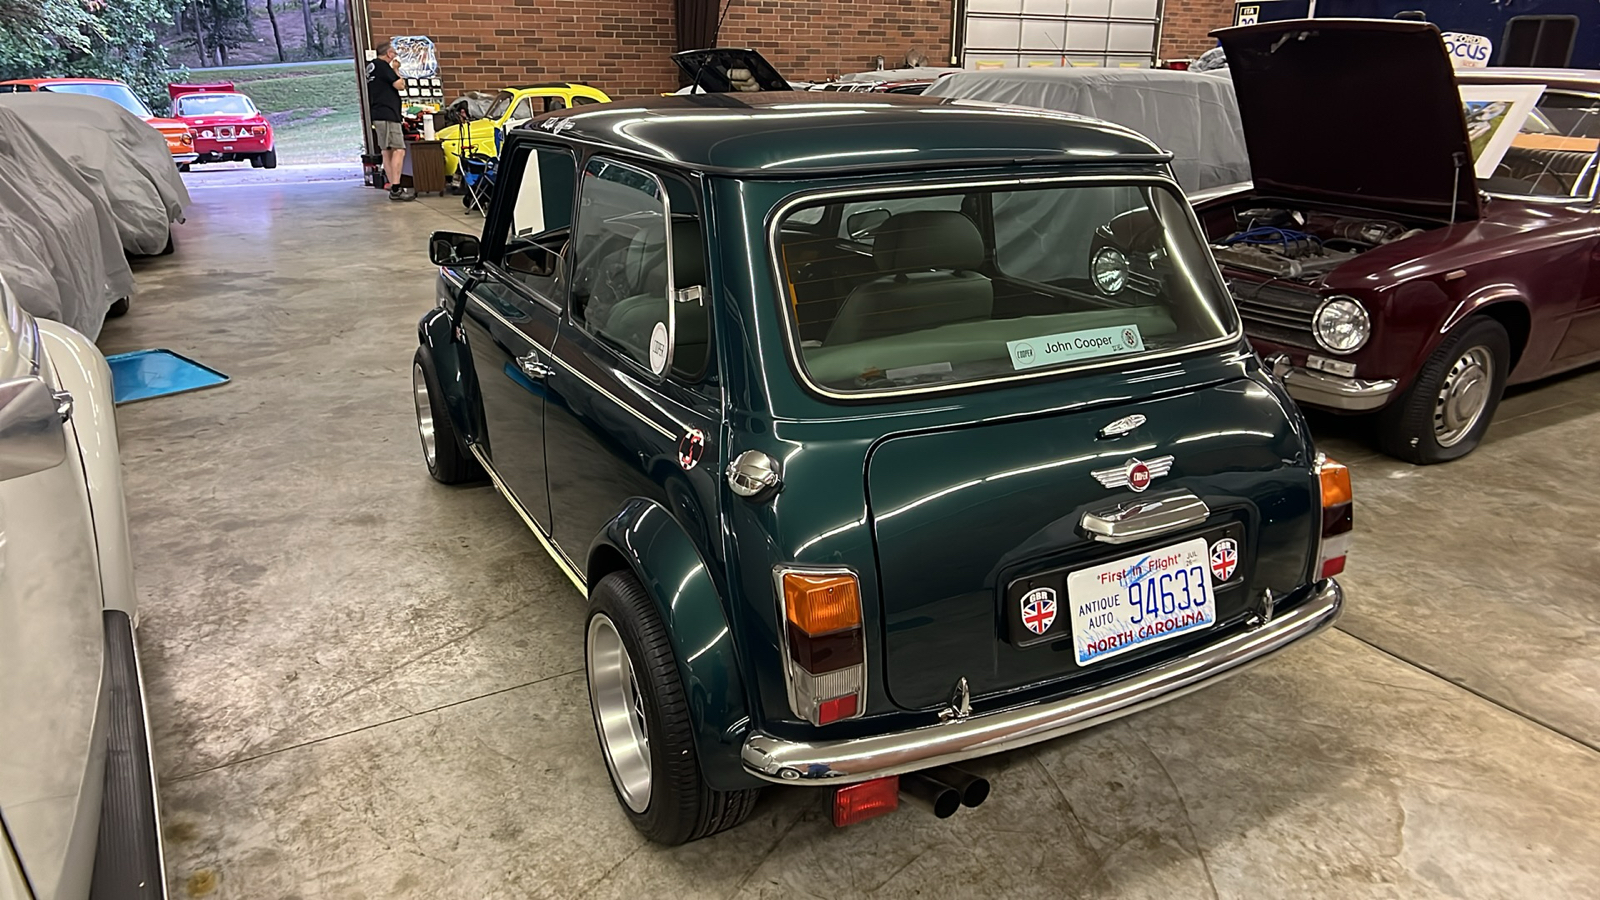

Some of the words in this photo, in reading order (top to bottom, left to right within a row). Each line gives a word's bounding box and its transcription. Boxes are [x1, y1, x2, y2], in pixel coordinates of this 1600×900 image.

[1045, 342, 1073, 354] John
[1074, 336, 1112, 349] Cooper
[1216, 541, 1231, 551] GBR
[1029, 591, 1048, 602] GBR
[1128, 566, 1207, 624] 94633
[1079, 594, 1120, 617] ANTIQUE
[1088, 612, 1114, 630] AUTO
[1087, 630, 1134, 656] NORTH
[1138, 610, 1205, 639] CAROLINA
